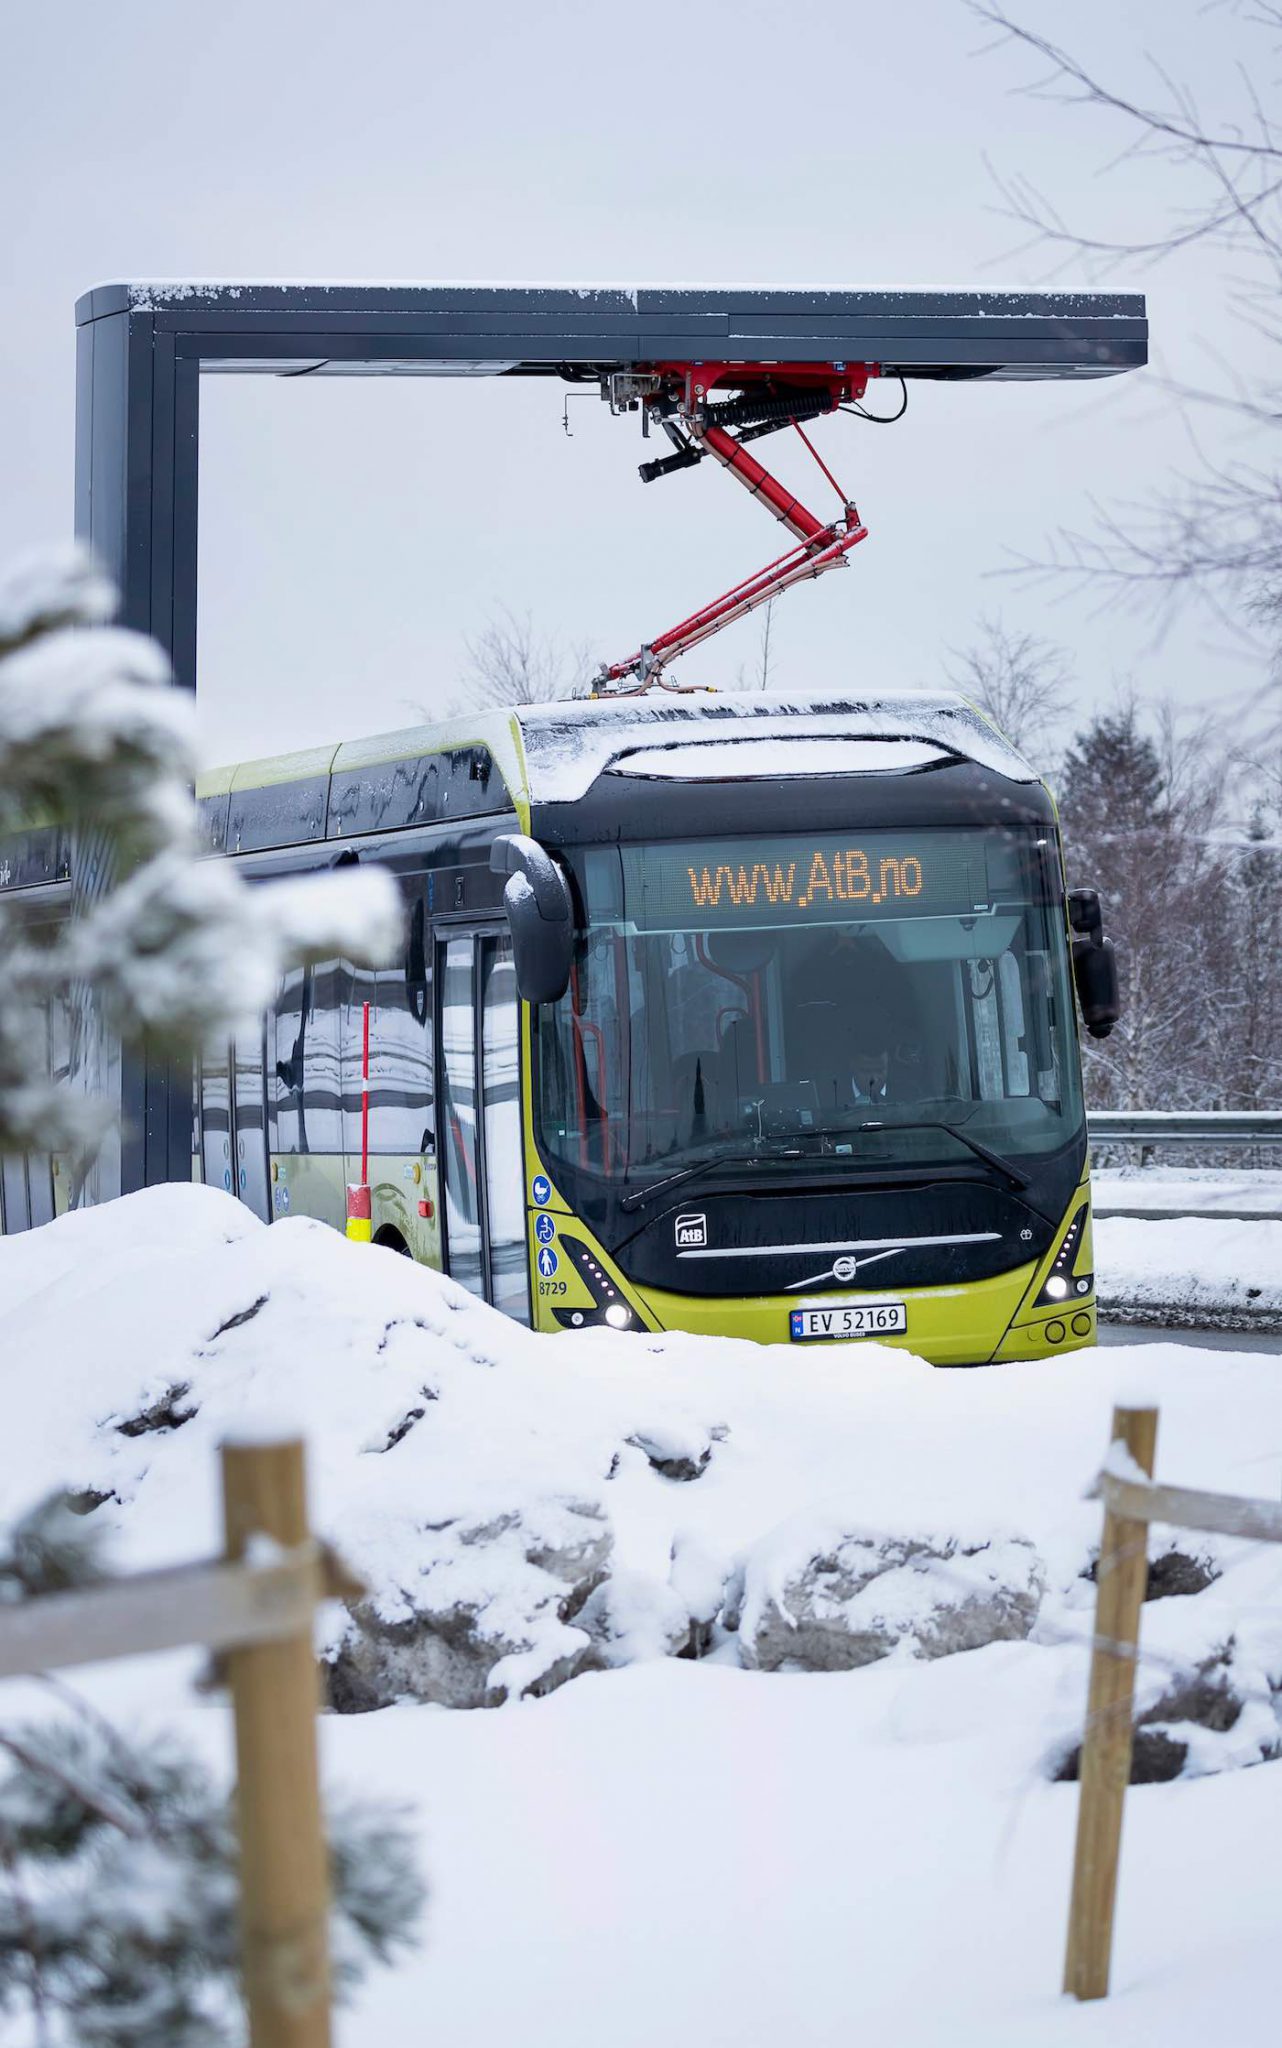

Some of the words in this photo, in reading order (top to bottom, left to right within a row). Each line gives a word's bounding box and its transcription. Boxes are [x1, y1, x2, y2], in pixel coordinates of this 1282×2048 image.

[687, 850, 922, 907] www.AtB.no
[680, 1228, 703, 1243] AtB
[539, 1281, 567, 1296] 8729
[810, 1314, 832, 1333] EV
[843, 1309, 899, 1330] 52169
